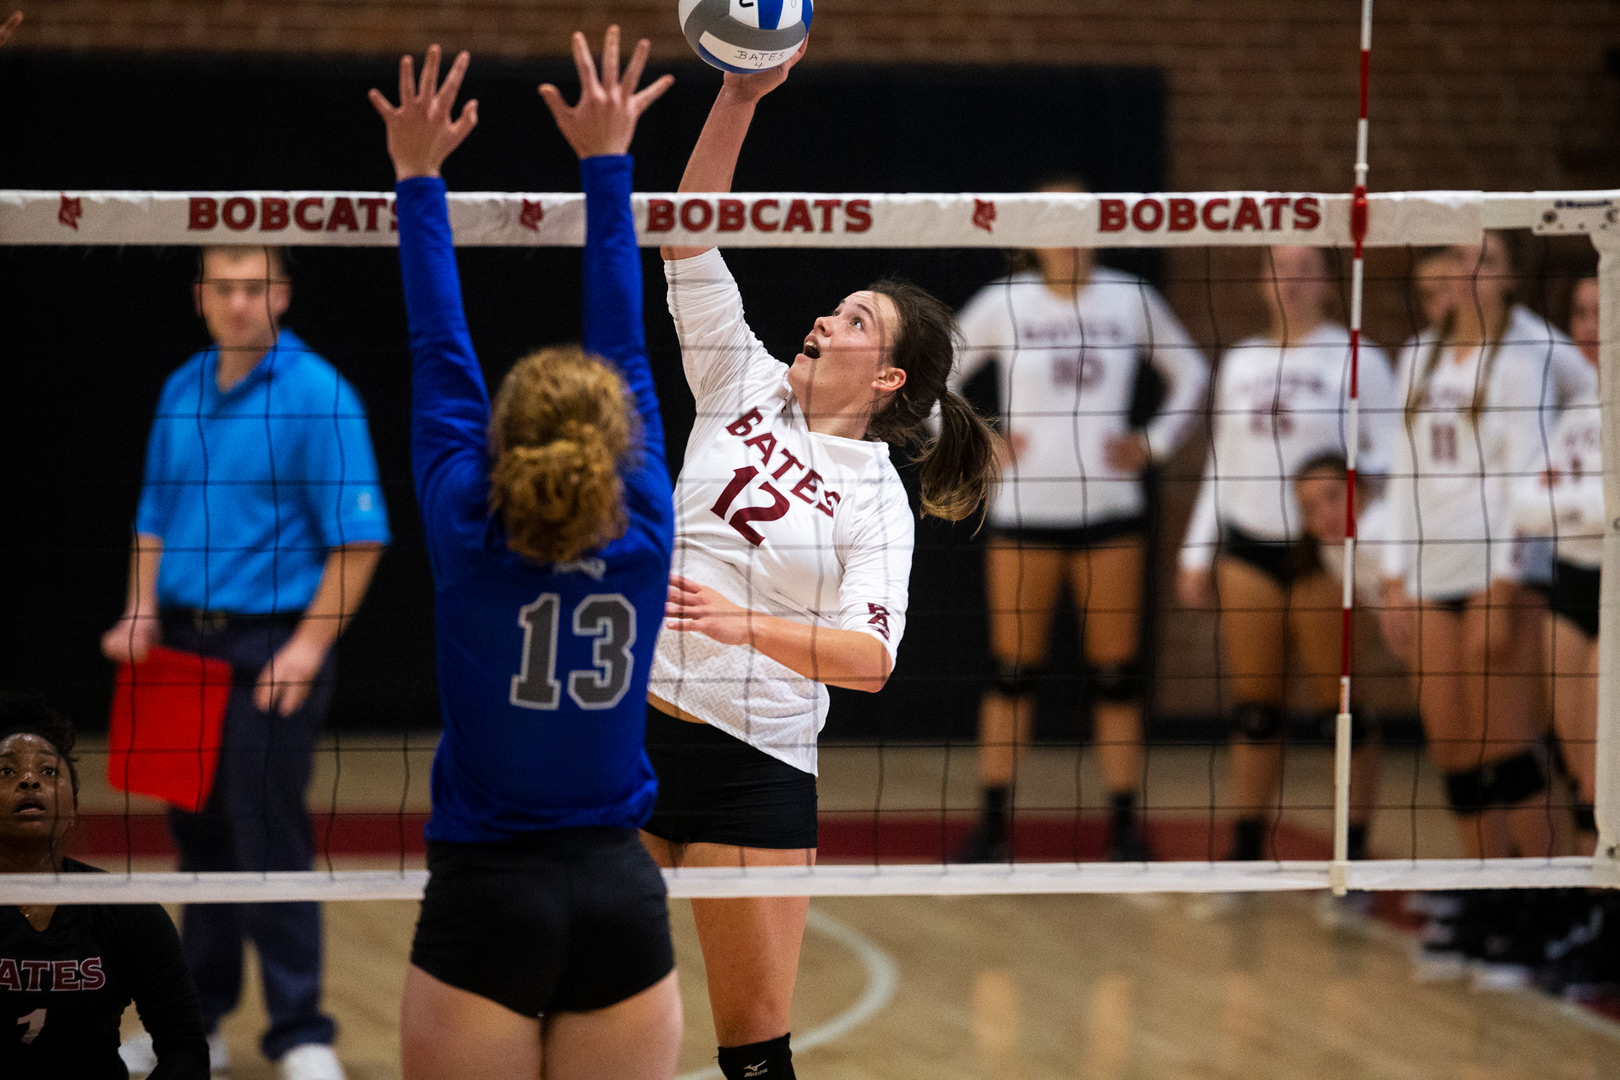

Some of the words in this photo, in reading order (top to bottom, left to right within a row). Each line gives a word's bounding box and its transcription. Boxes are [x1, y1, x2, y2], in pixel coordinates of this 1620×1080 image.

[734, 50, 785, 61] BATES
[187, 197, 399, 232] BOBCAT
[645, 199, 873, 233] BOBCATS
[1096, 197, 1322, 233] BOBCATS
[725, 406, 842, 518] BATES
[710, 466, 791, 547] 12
[509, 592, 637, 710] 13
